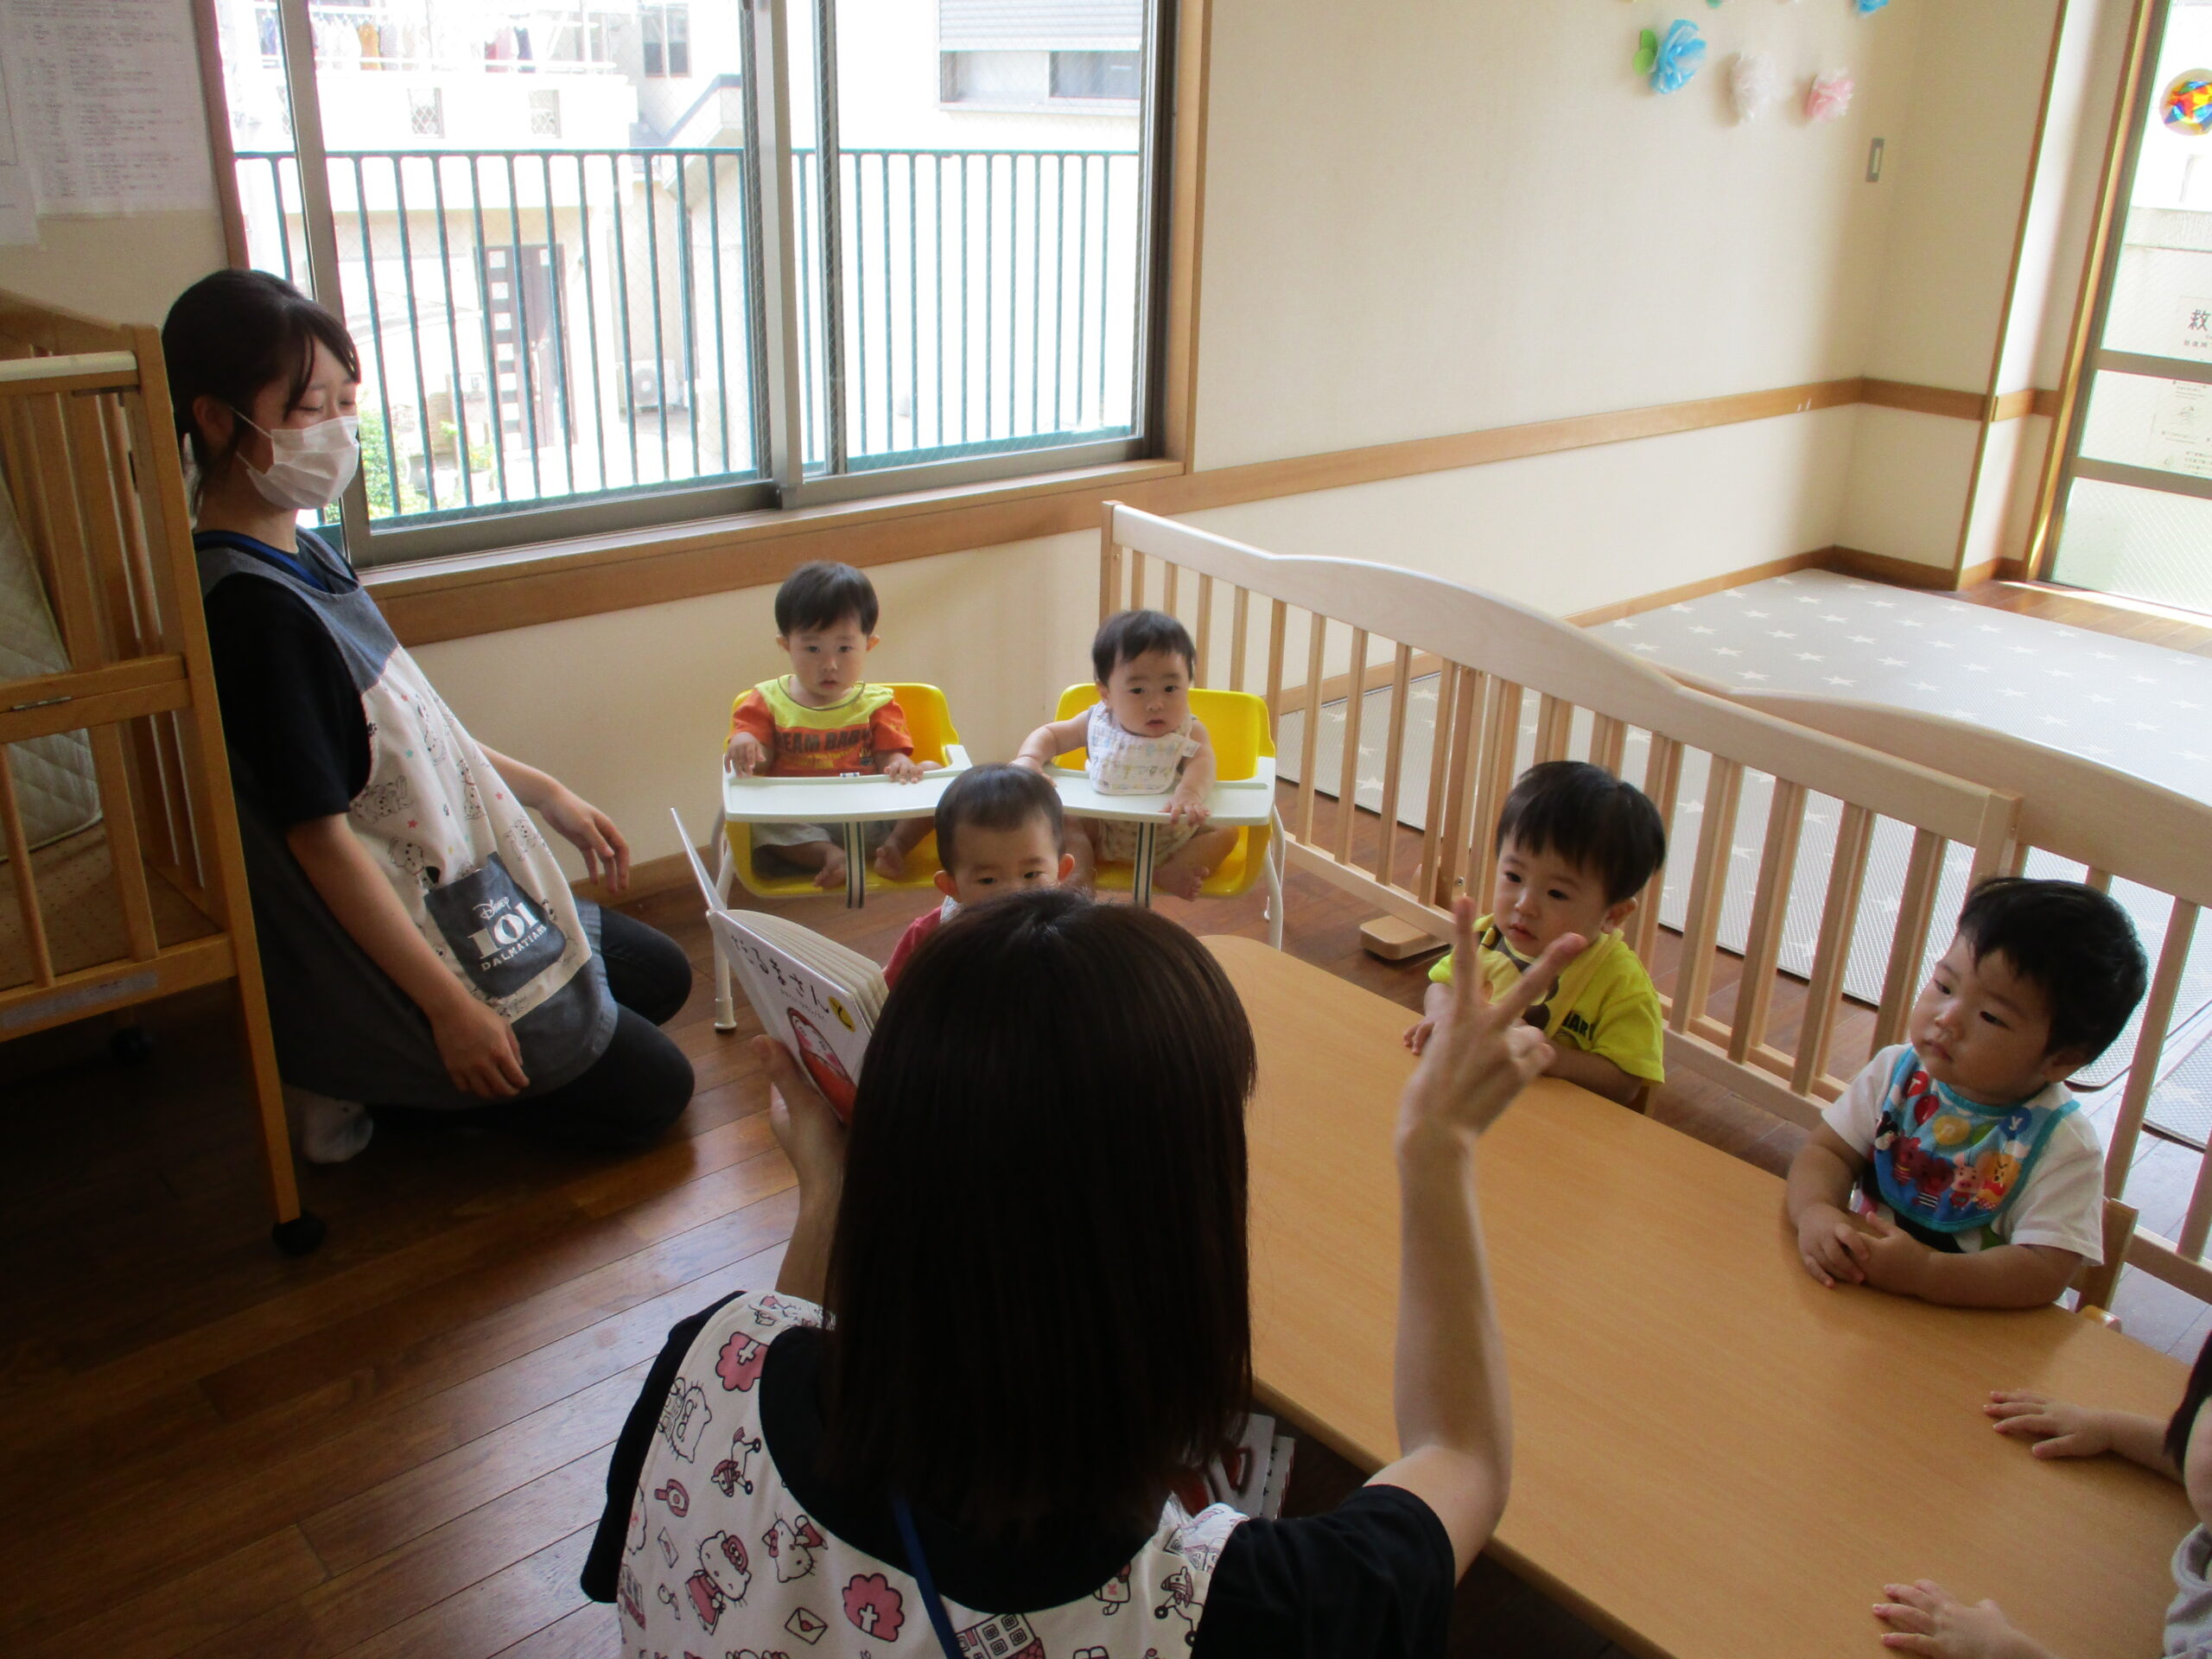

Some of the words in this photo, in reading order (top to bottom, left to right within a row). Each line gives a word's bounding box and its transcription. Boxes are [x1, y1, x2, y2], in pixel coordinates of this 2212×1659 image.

[467, 902, 539, 960] 101
[472, 897, 512, 921] Disney
[480, 924, 547, 972] DALMATIANS
